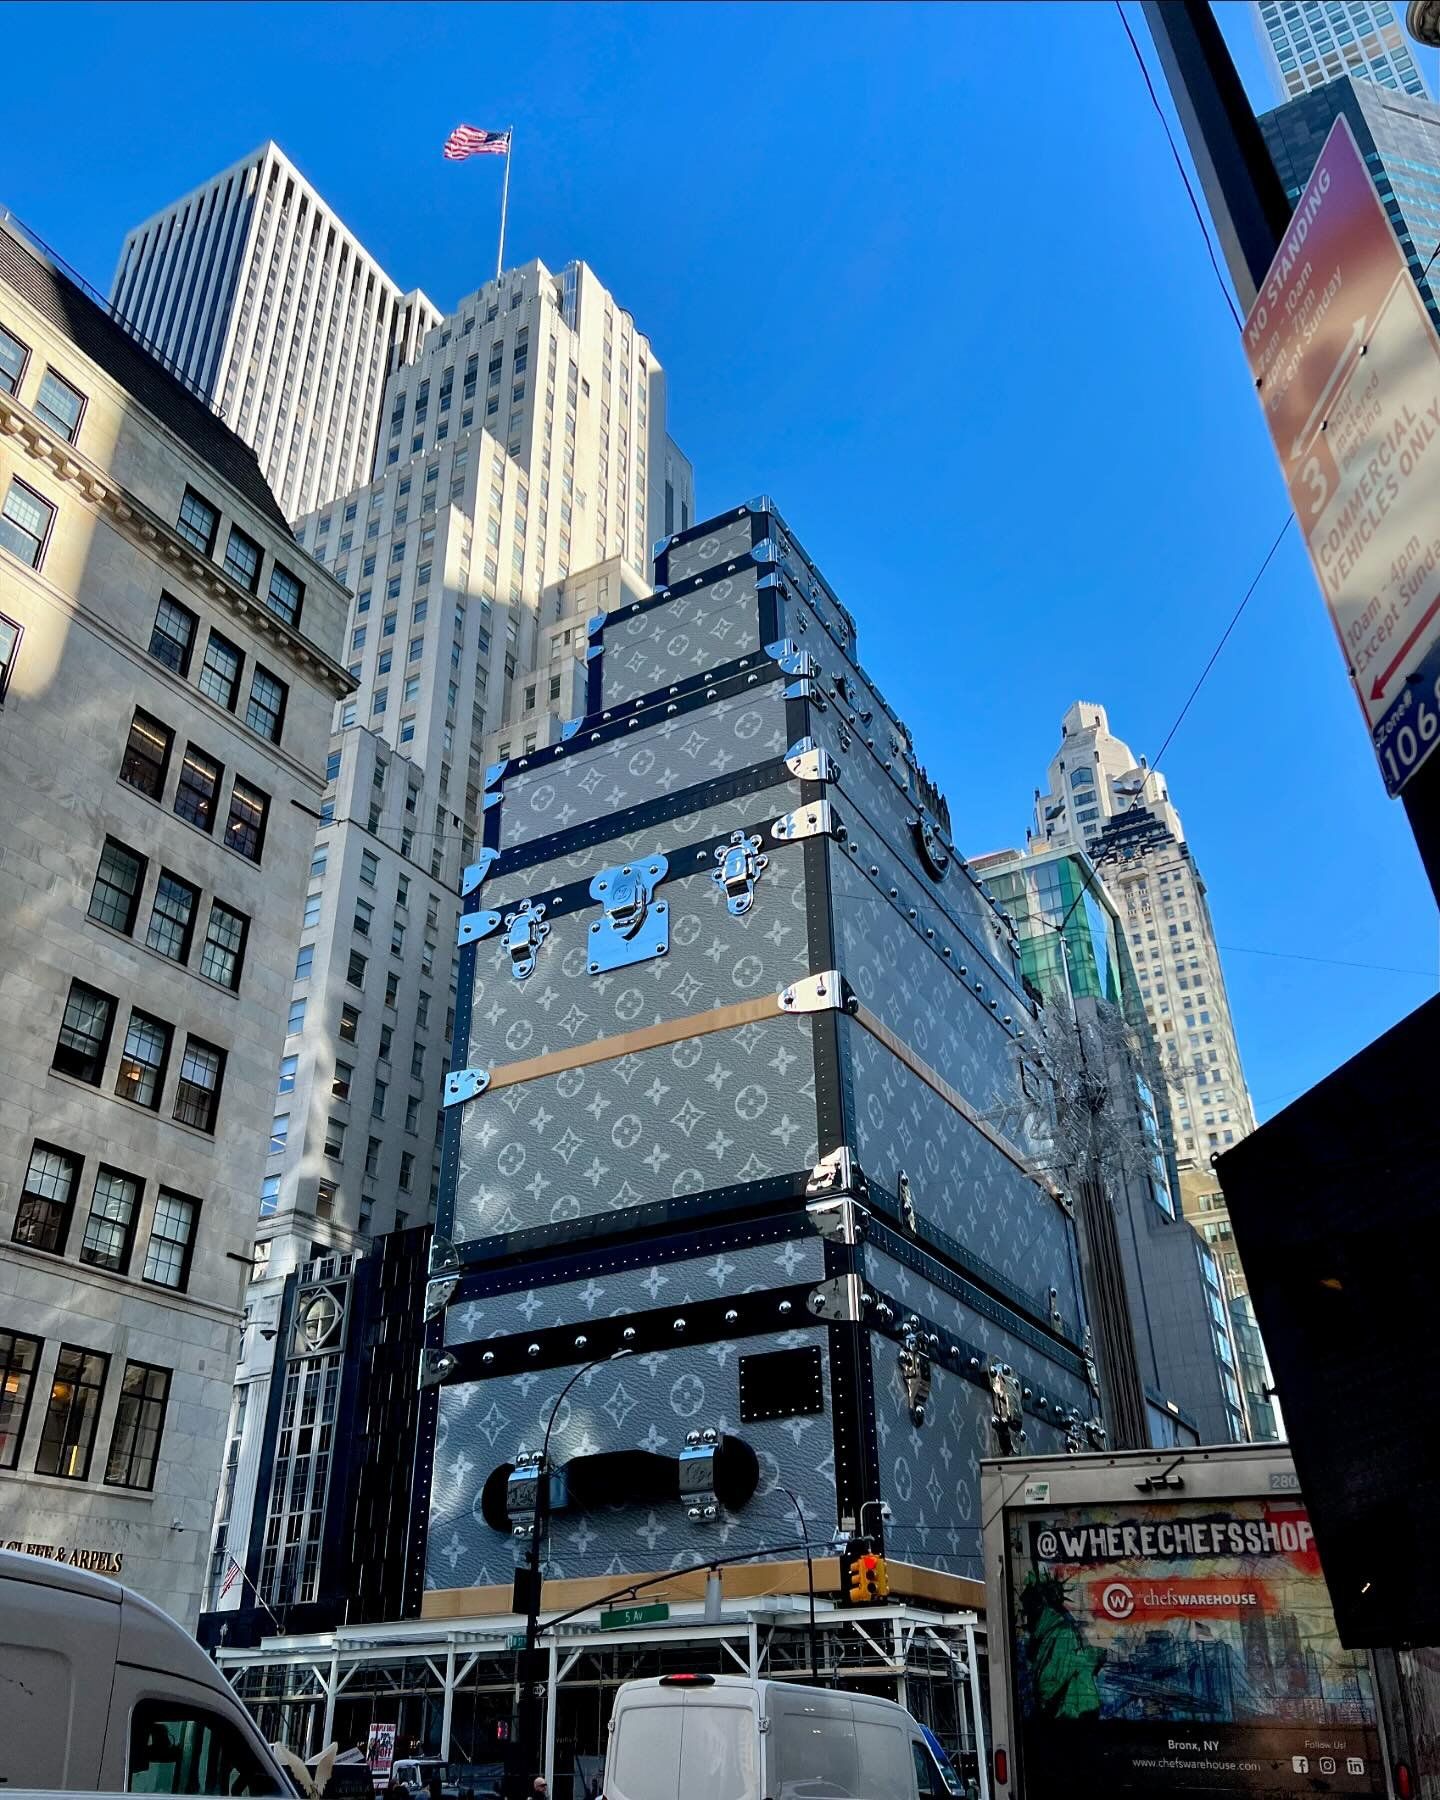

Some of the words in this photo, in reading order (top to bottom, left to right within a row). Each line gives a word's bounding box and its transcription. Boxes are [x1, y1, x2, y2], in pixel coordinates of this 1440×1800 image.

[1248, 306, 1268, 348] NO
[1267, 167, 1331, 309] STANDING
[1284, 261, 1313, 316] 10am
[1291, 287, 1316, 333] 7pm
[1302, 264, 1343, 345] Sunday
[1301, 455, 1328, 514] 3
[1319, 404, 1417, 568] COMMERCIAL
[1327, 474, 1399, 593] VEHICLES
[1399, 395, 1440, 478] ONLY
[1346, 596, 1382, 648] 10am
[1390, 534, 1421, 585] 4pm
[1354, 603, 1401, 675] Except
[1399, 538, 1440, 609] Sunda
[1385, 676, 1440, 782] 106
[54, 1546, 67, 1562] &
[68, 1549, 124, 1573] ARPELS
[1036, 1520, 1315, 1560] @WHERECHEFSSHOP
[625, 1612, 631, 1623] 5
[634, 1611, 643, 1622] Av
[1132, 1757, 1262, 1772] www.chefswarehouse.com
[1168, 1739, 1201, 1752] Bronx,
[1203, 1740, 1220, 1751] NY
[1304, 1740, 1331, 1750] Follow
